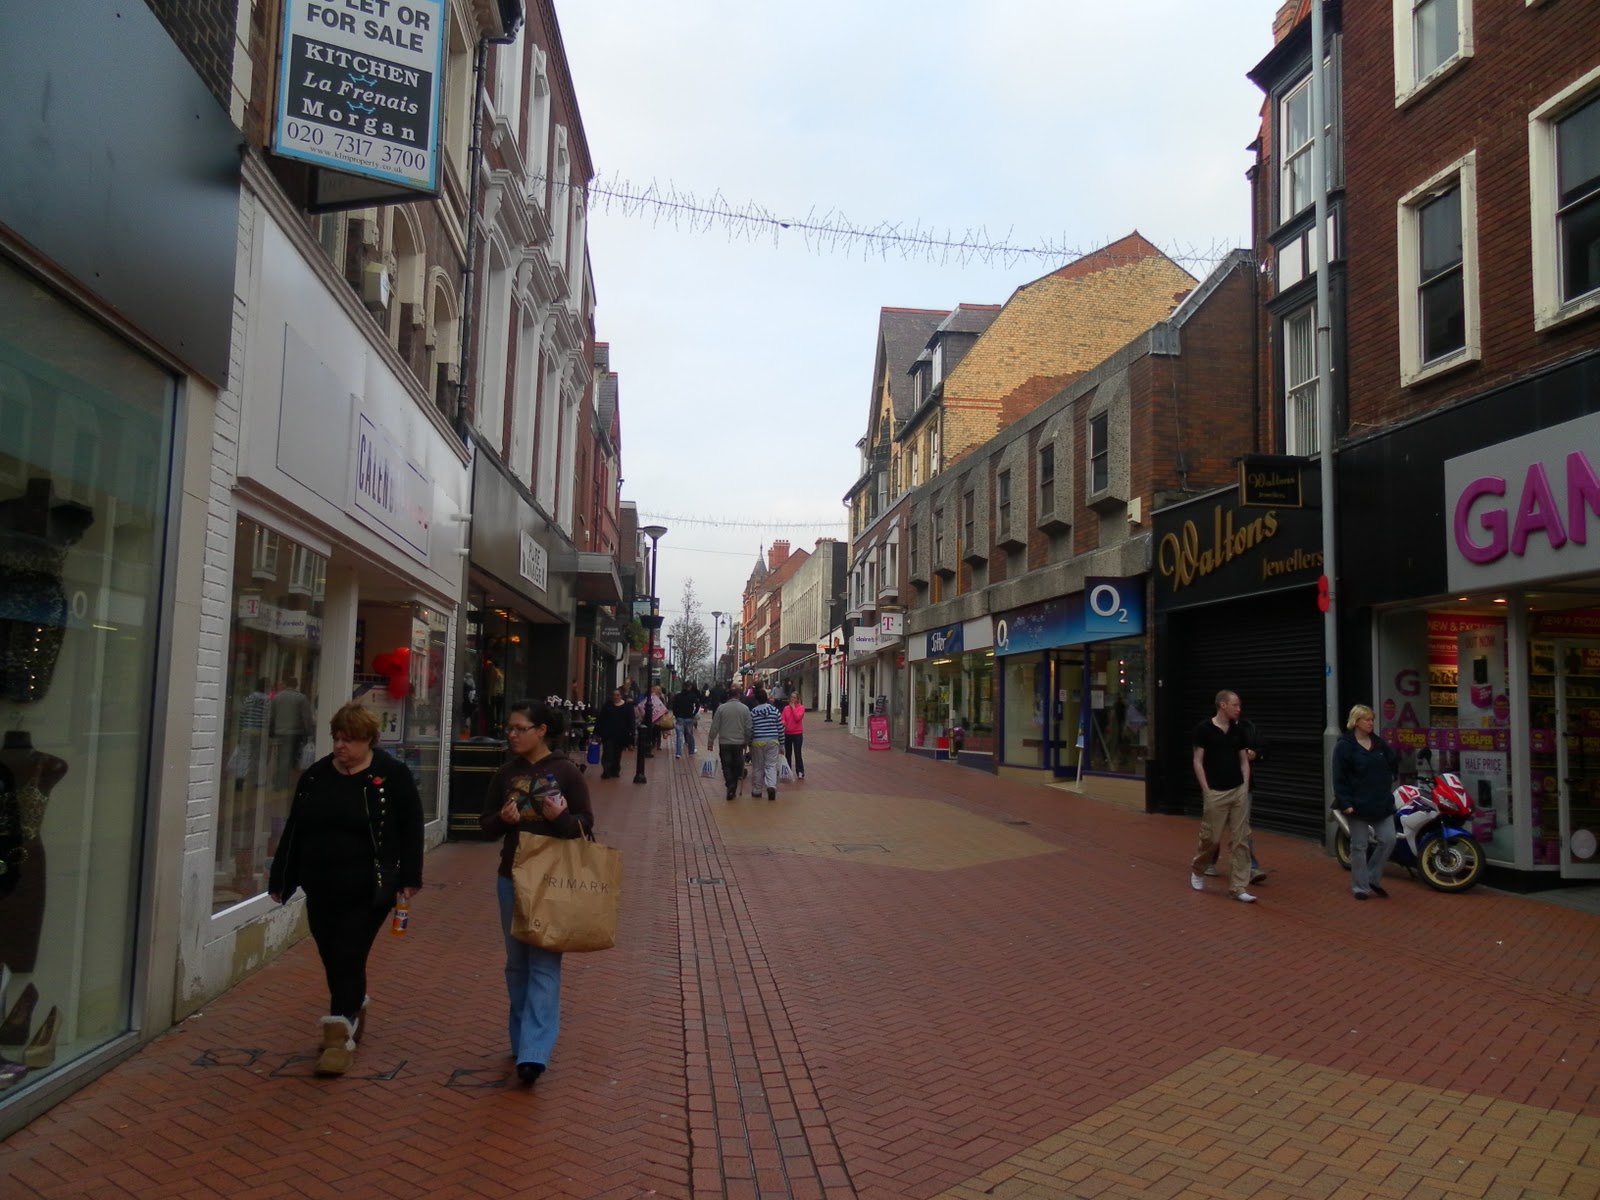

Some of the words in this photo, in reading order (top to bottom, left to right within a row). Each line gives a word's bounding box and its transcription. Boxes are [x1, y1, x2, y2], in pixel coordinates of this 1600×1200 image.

[307, 3, 356, 34] FOR
[364, 19, 424, 53] SALE
[398, 6, 430, 32] OR
[305, 42, 420, 88] KITCHEN
[302, 71, 332, 92] La
[338, 80, 419, 115] Frenais
[301, 97, 416, 142] Morgan
[287, 121, 324, 146] 020
[334, 133, 373, 158] 7317
[382, 145, 426, 171] 3700
[1248, 472, 1295, 488] Waltons
[1158, 504, 1279, 592] Waltons
[1262, 549, 1324, 581] Jewellers
[882, 616, 894, 631] T
[1483, 758, 1502, 771] PRICE
[543, 873, 609, 894] PRIMARK
